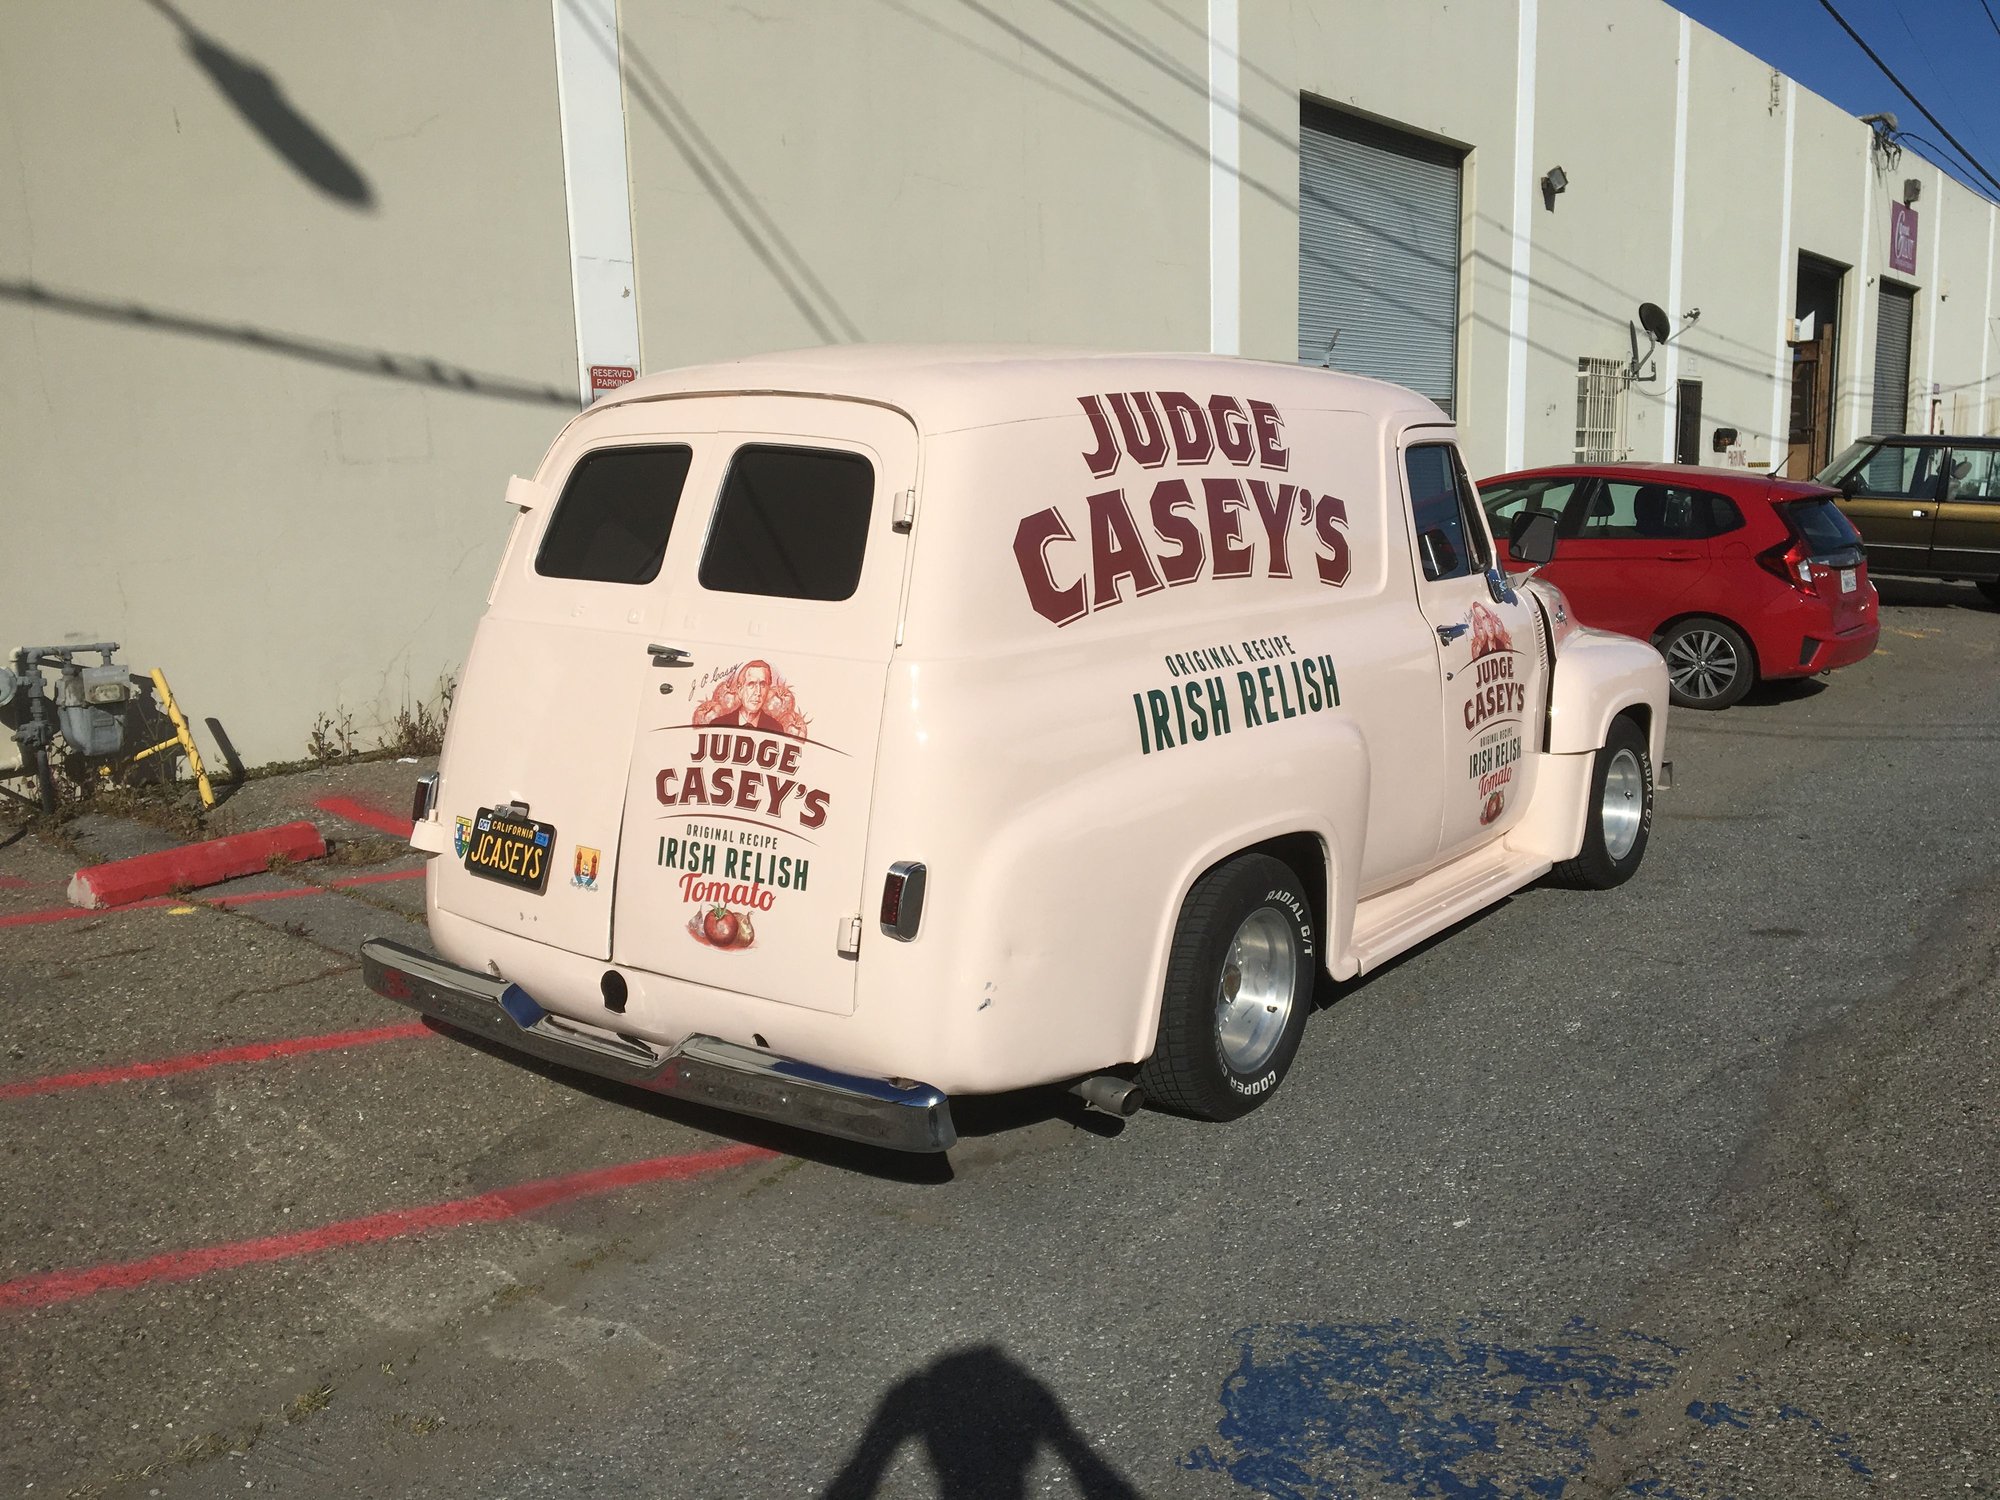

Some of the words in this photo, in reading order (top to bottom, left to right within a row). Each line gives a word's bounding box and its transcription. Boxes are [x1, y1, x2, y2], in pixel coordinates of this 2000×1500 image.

[592, 368, 632, 378] RESERVED
[1076, 391, 1290, 480] JUDGE
[1013, 478, 1352, 628] CASEY'S
[1165, 644, 1243, 677] ORIGINAL
[1242, 635, 1296, 662] RECIPE
[1476, 656, 1514, 689] JUDGE
[1133, 676, 1232, 755] IRISH
[1237, 654, 1341, 728] RELISH
[1464, 682, 1525, 732] CASEY'S
[690, 733, 803, 776] JUDGE
[1469, 746, 1493, 779] IRISH
[1495, 735, 1522, 768] RELISH
[655, 767, 831, 830] CASEY'S
[1479, 764, 1512, 800] Tomato
[492, 820, 534, 840] CALIFORNIA
[686, 824, 734, 843] ORIGINAL
[739, 833, 778, 850] RECIPE
[470, 833, 543, 879] JCASEYS
[657, 836, 716, 875] IRISH
[724, 847, 809, 891] RELISH
[678, 873, 777, 911] Tomato
[1264, 889, 1301, 922] RADIAL
[1300, 924, 1313, 957] G/T
[1230, 1070, 1277, 1095] COOPER
